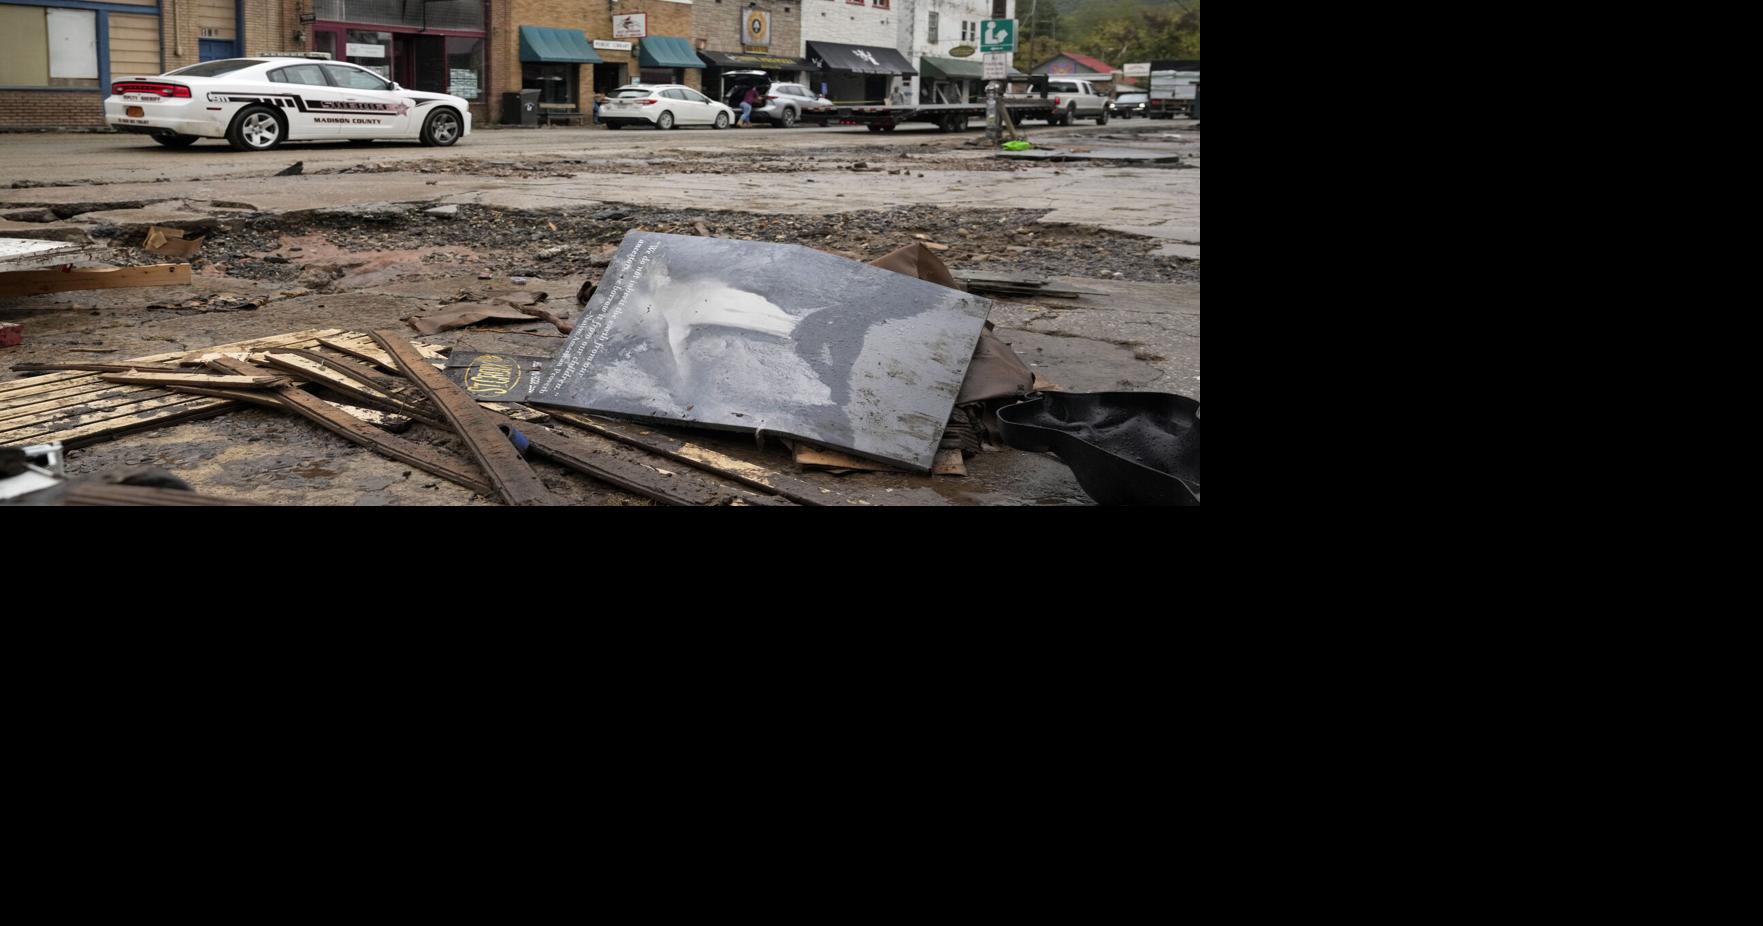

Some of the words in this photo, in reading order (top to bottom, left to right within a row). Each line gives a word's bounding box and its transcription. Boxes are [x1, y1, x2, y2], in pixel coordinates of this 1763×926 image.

[640, 255, 650, 265] do
[632, 266, 643, 279] not
[602, 284, 622, 312] borrow
[586, 319, 601, 339] from
[577, 341, 587, 355] our
[586, 340, 604, 361] from
[579, 361, 592, 377] our
